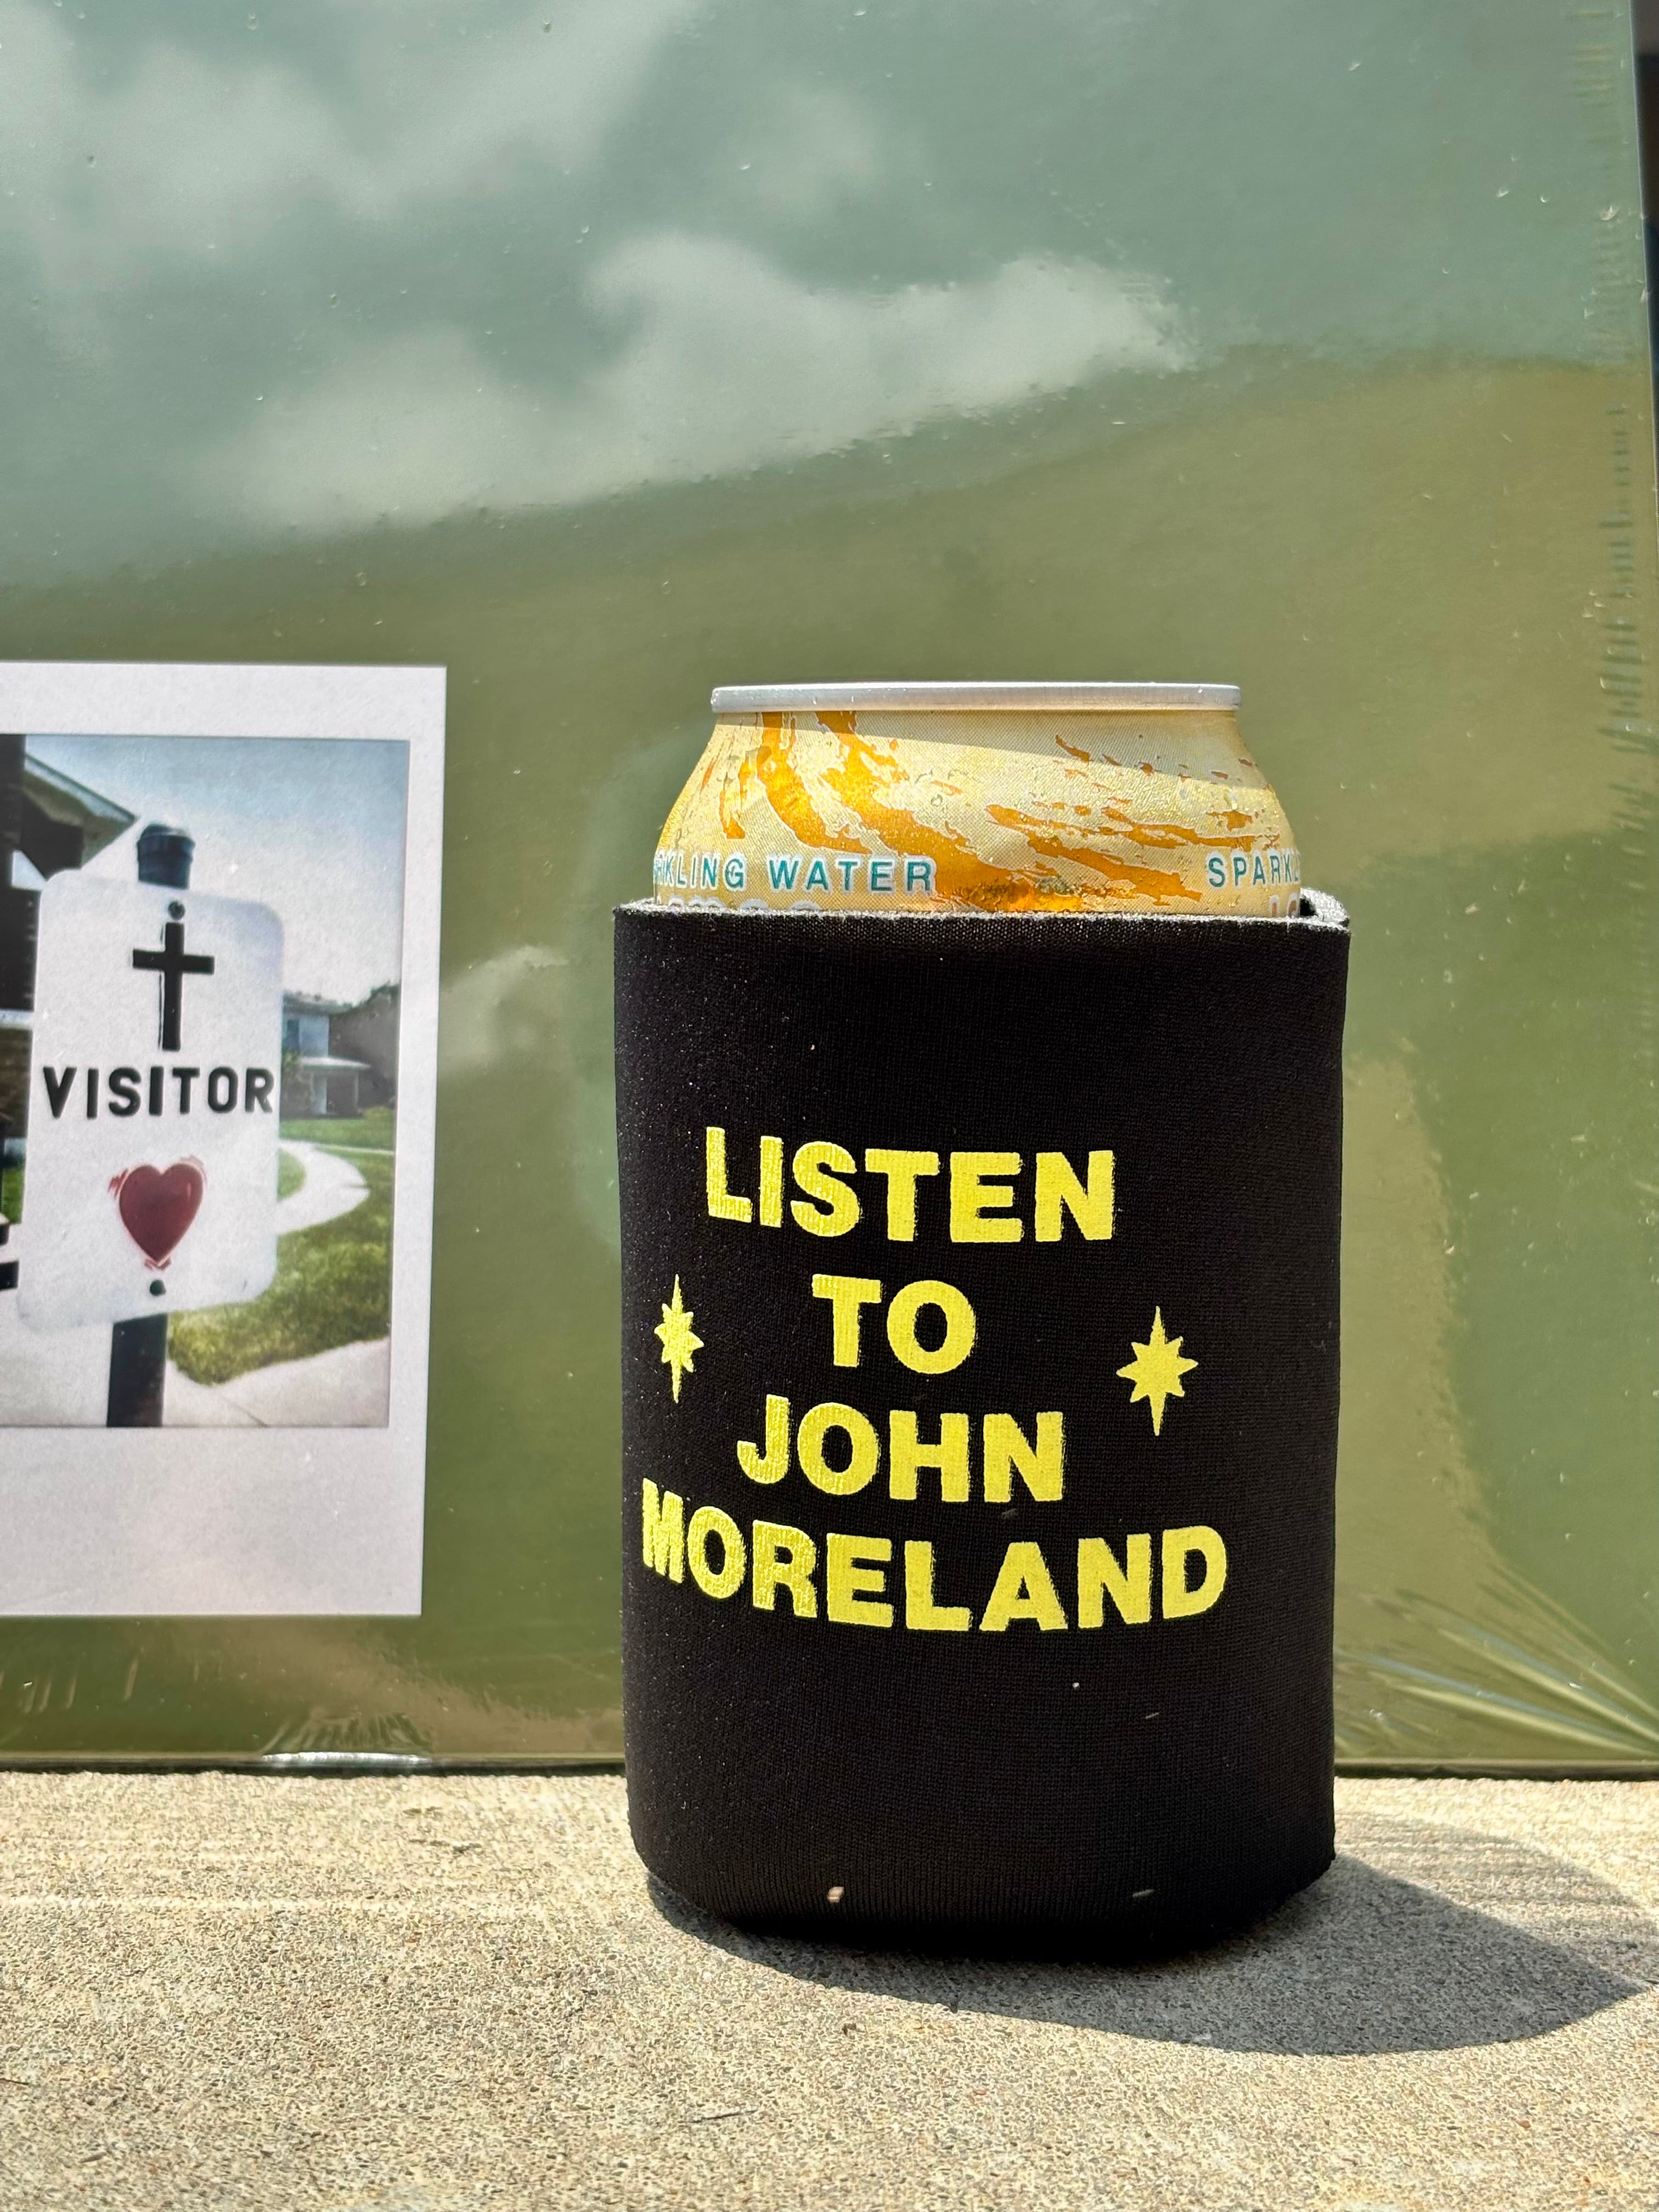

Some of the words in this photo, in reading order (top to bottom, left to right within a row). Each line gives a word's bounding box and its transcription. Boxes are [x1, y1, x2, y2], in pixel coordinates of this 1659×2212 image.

[769, 859, 933, 891] WATER
[43, 1066, 274, 1120] VISITOR
[706, 1126, 1115, 1243] LISTEN
[811, 1273, 976, 1375] TO
[737, 1394, 1065, 1503] JOHN
[642, 1478, 1227, 1633] MORELAND
